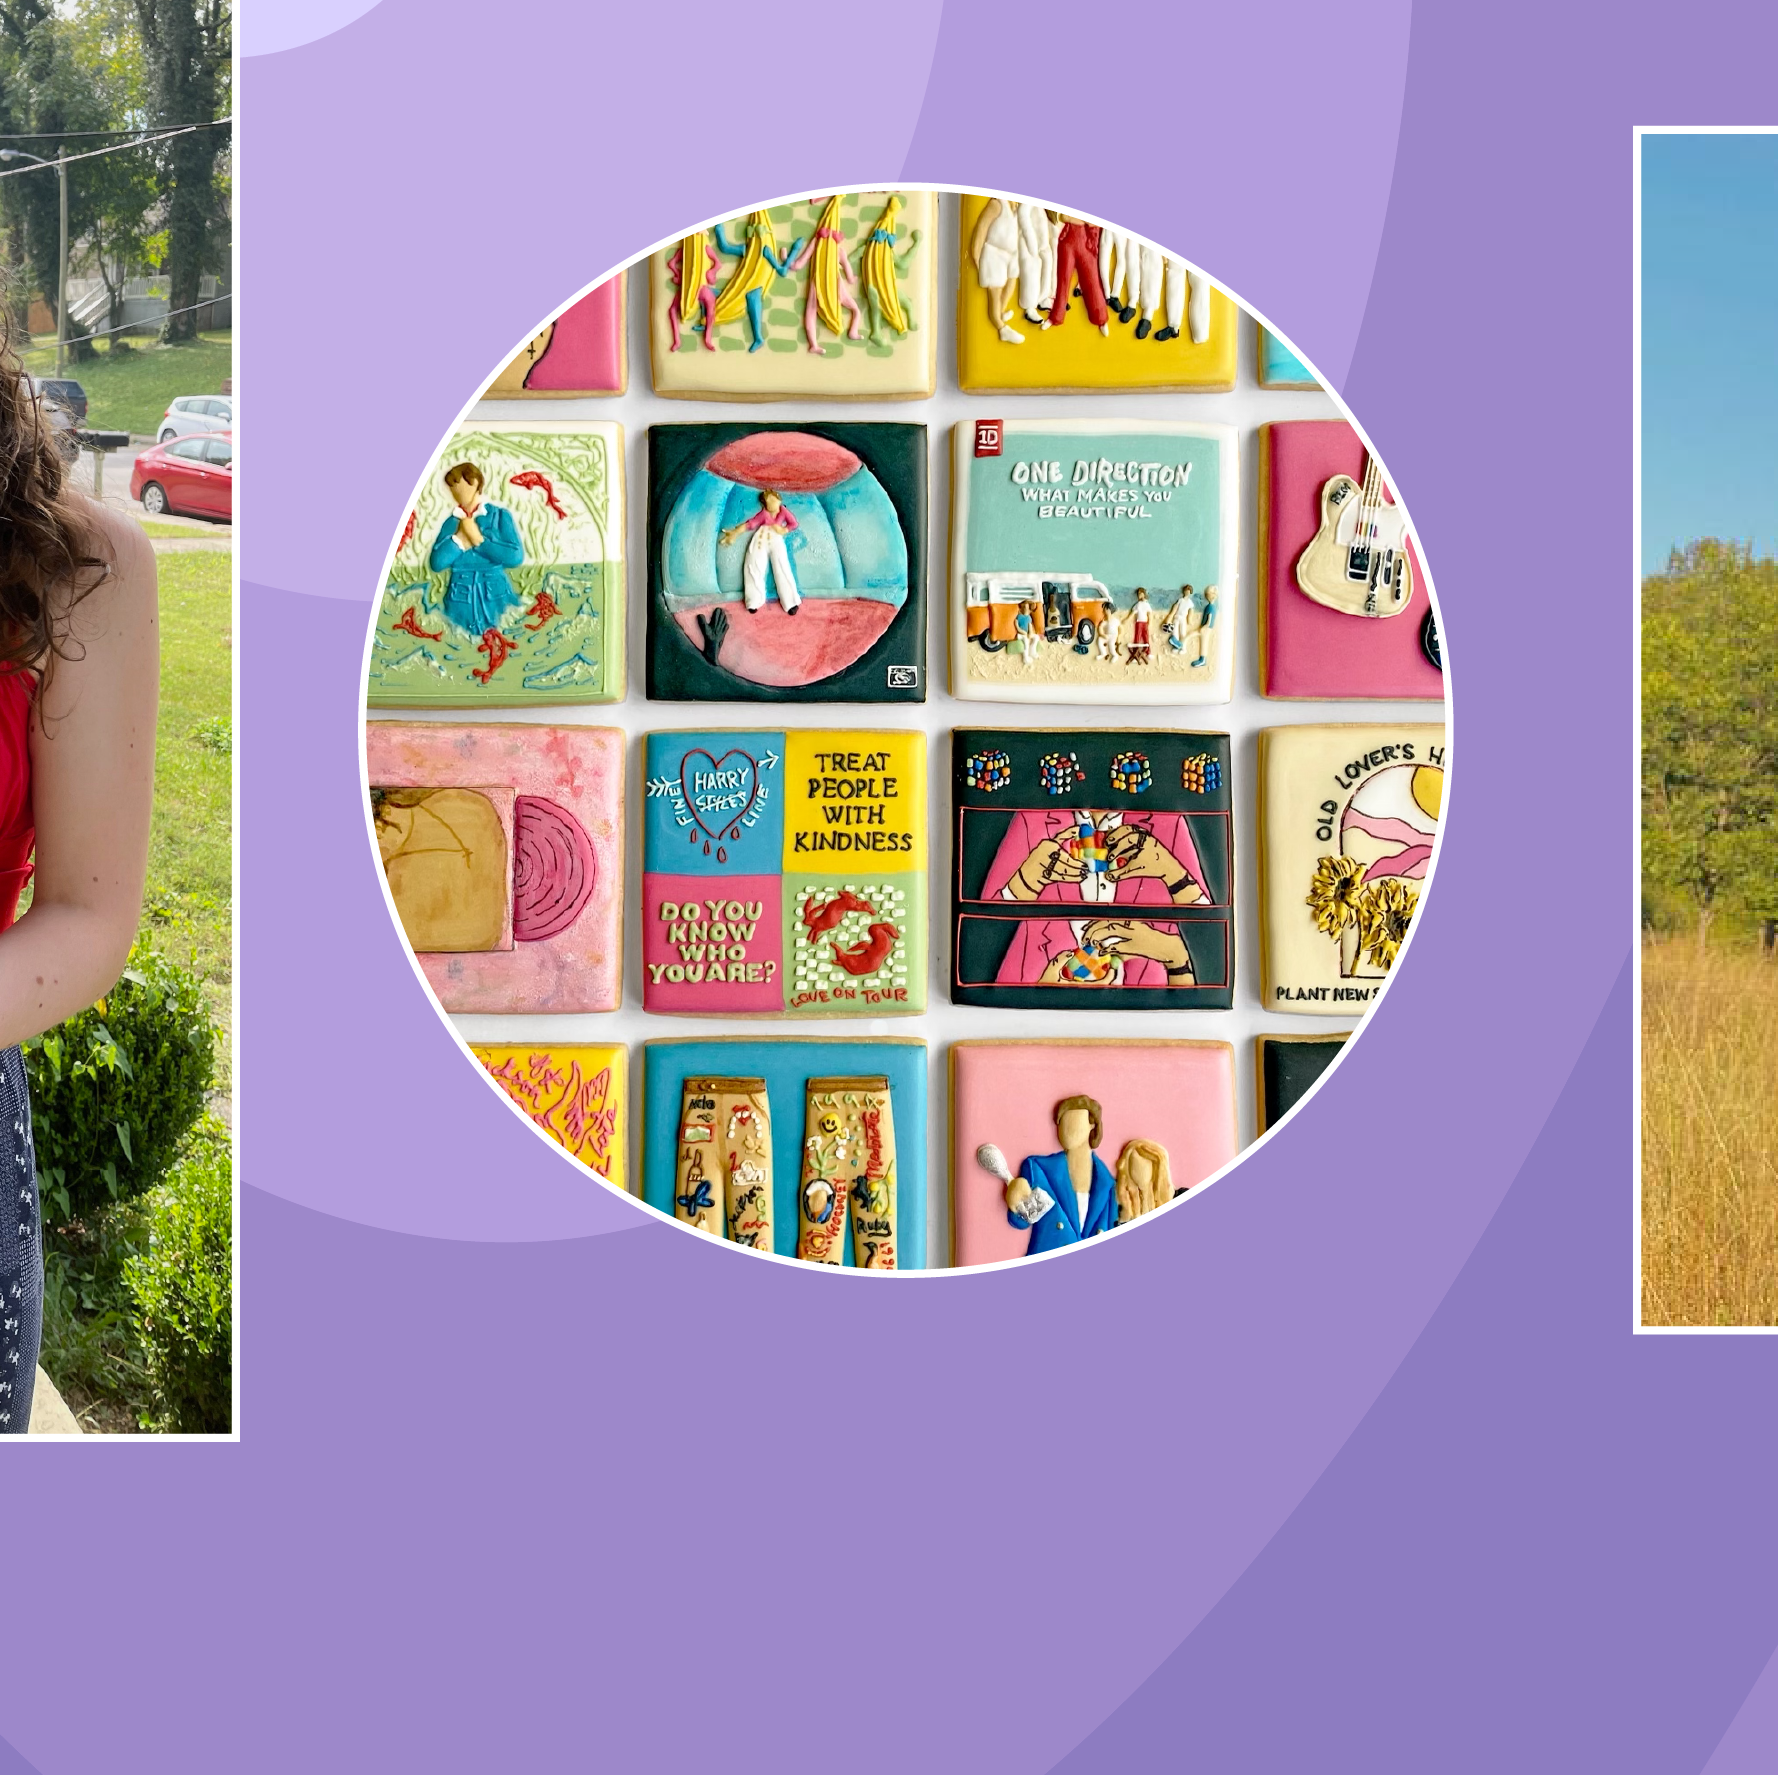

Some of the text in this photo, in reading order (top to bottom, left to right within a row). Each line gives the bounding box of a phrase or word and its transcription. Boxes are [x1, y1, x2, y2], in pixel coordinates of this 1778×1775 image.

[978, 430, 998, 444] 1D
[1012, 458, 1192, 488] ONE DIRECTION
[1022, 488, 1171, 503] WHAT MAKES YOU
[1038, 505, 1151, 519] BEAUTIFUL
[815, 752, 891, 772] TREAT
[695, 768, 749, 792] HARRY
[808, 777, 898, 800] PEOPLE
[1316, 743, 1415, 841] OLD LOVER'S
[668, 787, 694, 826] FINE
[742, 784, 769, 827] LINE
[822, 804, 885, 825] WITH
[794, 831, 913, 852] KINDNESS
[661, 900, 762, 921] DO YOU
[669, 921, 756, 943] KNOW
[679, 944, 746, 962] WHO
[791, 987, 908, 1008] LOVE ON TOUR
[1276, 986, 1330, 1001] PLANT
[1333, 987, 1369, 1001] NEW
